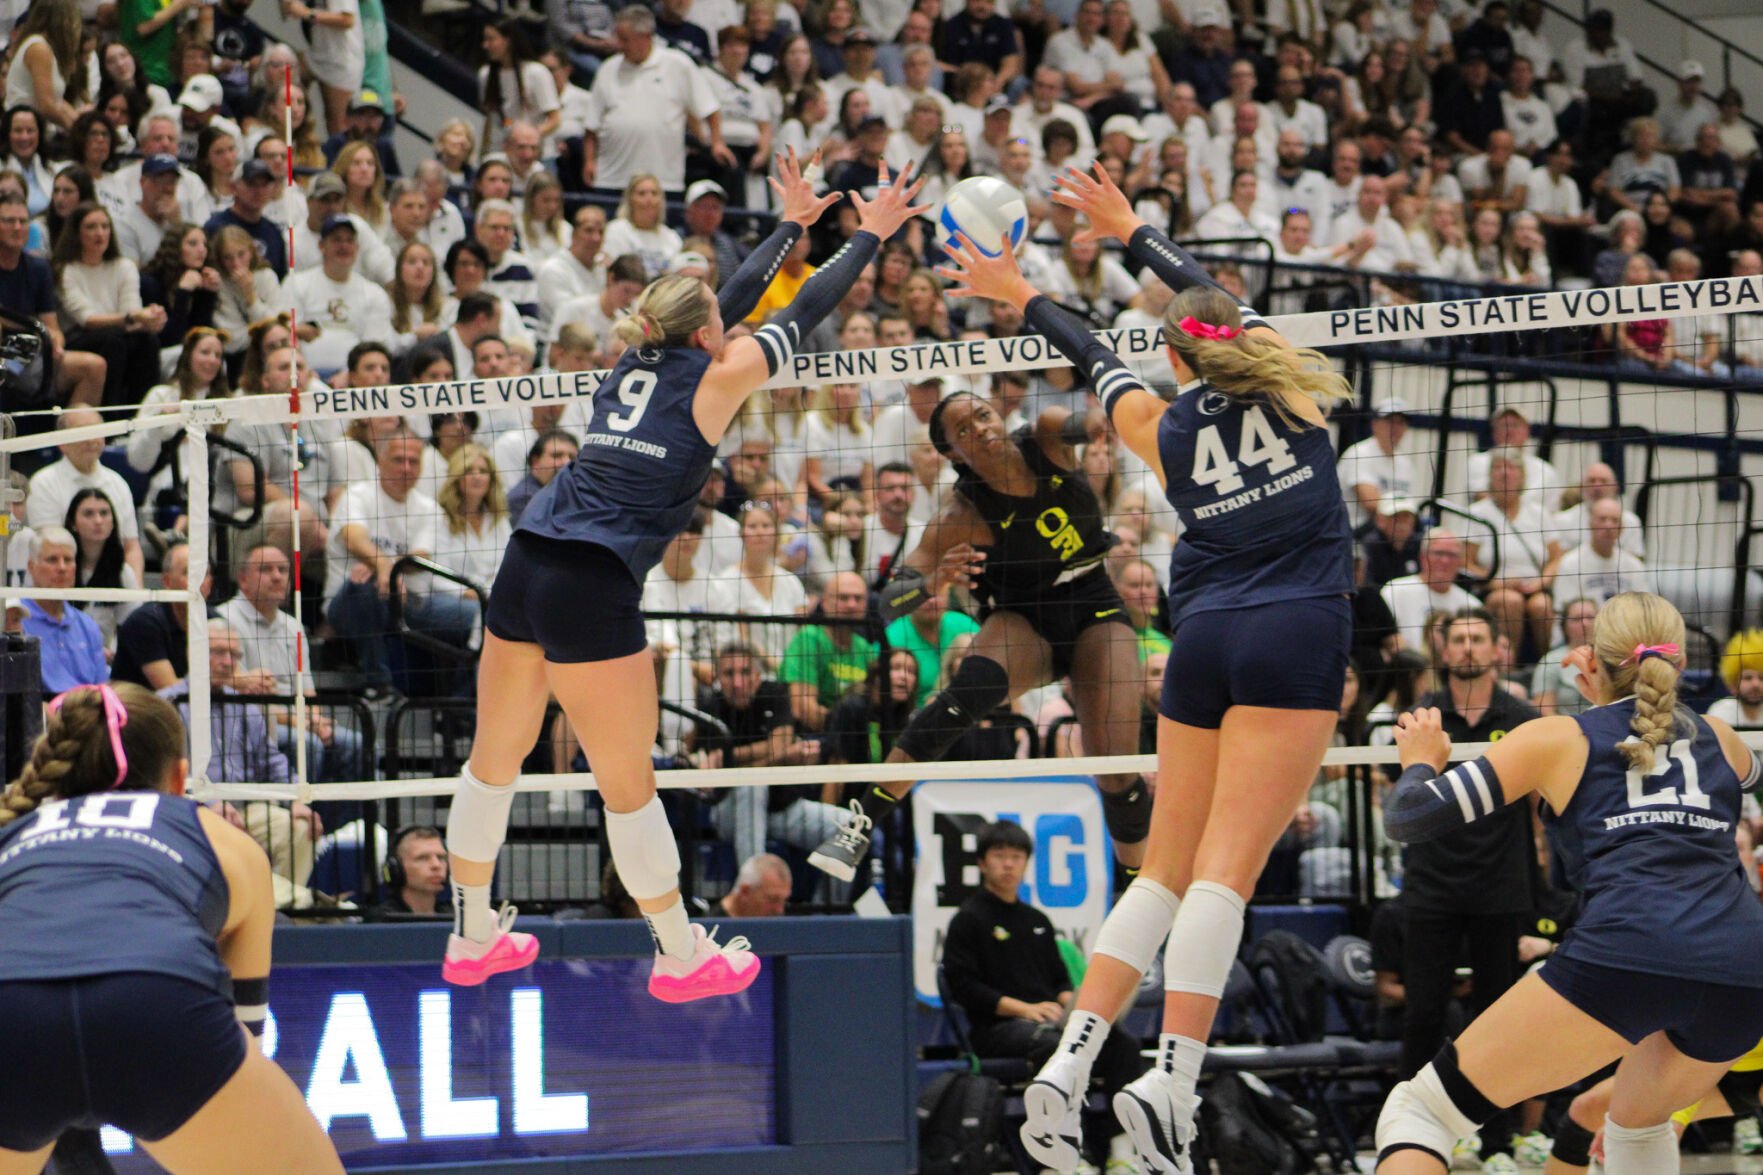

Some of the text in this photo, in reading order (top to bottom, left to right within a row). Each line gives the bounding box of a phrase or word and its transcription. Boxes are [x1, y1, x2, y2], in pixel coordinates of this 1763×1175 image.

[1330, 277, 1763, 337] PENN STATE VOLLEYBA
[793, 350, 877, 380] PENN
[890, 341, 987, 373] STATE
[313, 388, 390, 414] PENN
[400, 381, 486, 409] STATE
[606, 368, 658, 432] 9
[622, 437, 668, 459] LIONS
[1190, 404, 1297, 496] 44
[1193, 465, 1314, 520] NITTANY LIONS
[1603, 810, 1687, 831] NITTANY
[262, 987, 590, 1143] ALL
